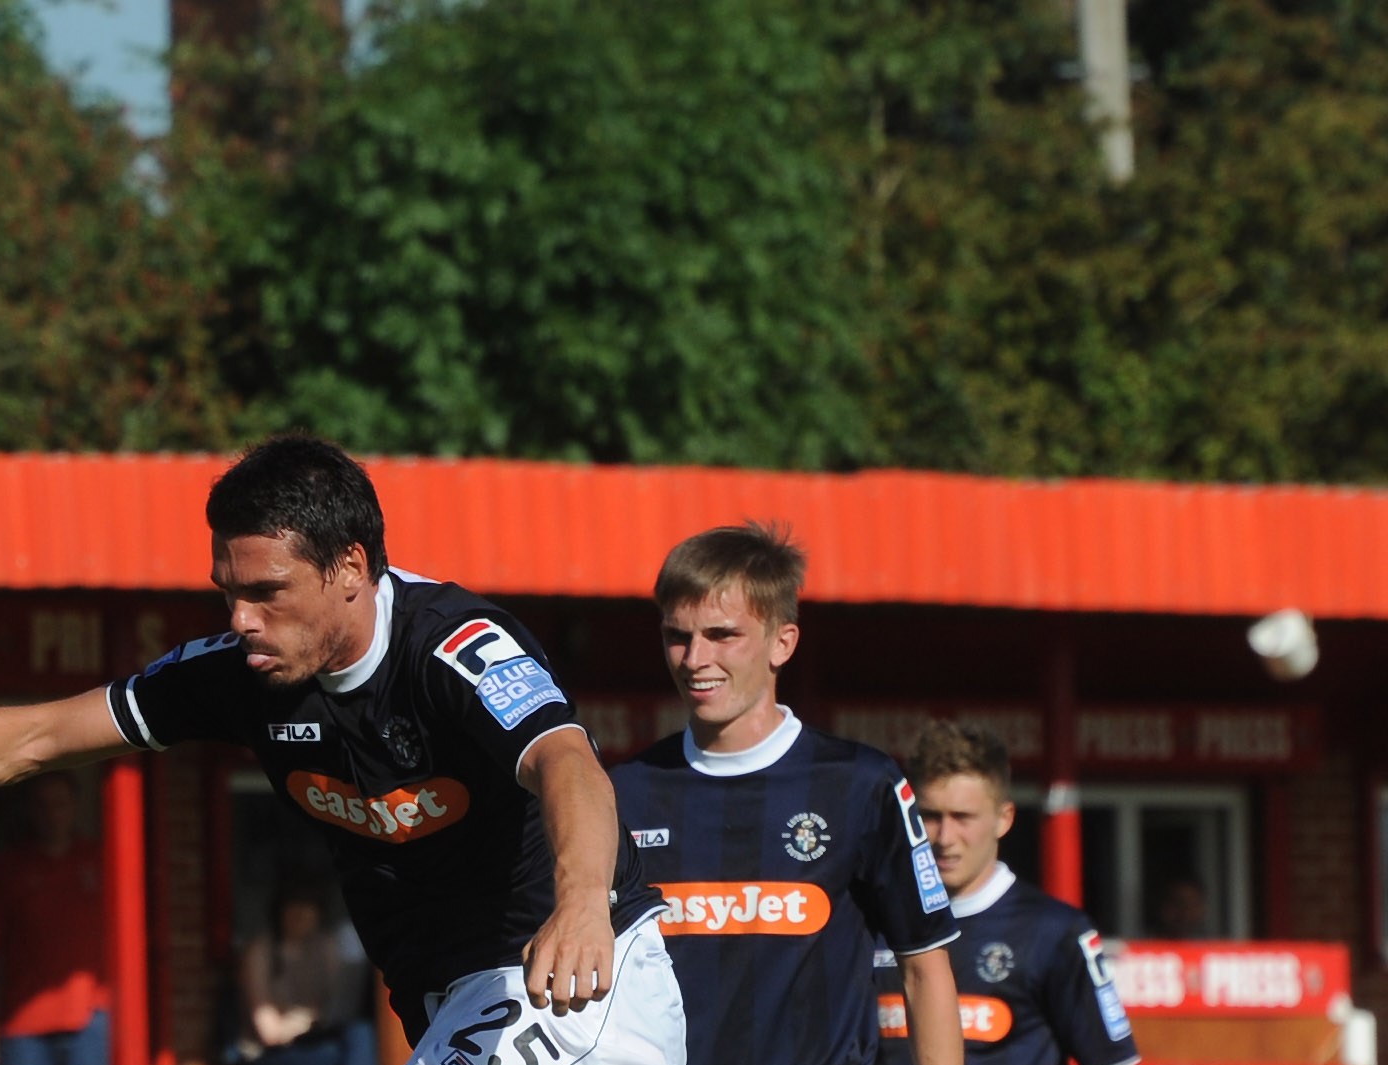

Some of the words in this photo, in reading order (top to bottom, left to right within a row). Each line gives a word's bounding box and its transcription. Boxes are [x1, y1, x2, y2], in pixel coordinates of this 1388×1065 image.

[479, 661, 540, 697] BLUE
[488, 681, 533, 711] SQ
[502, 689, 562, 724] PREMIER
[271, 725, 317, 740] FILA
[1077, 711, 1174, 760] PRESS
[1197, 711, 1291, 760] PRESS
[656, 885, 808, 931] asyJet
[1200, 951, 1304, 1009] PRESS
